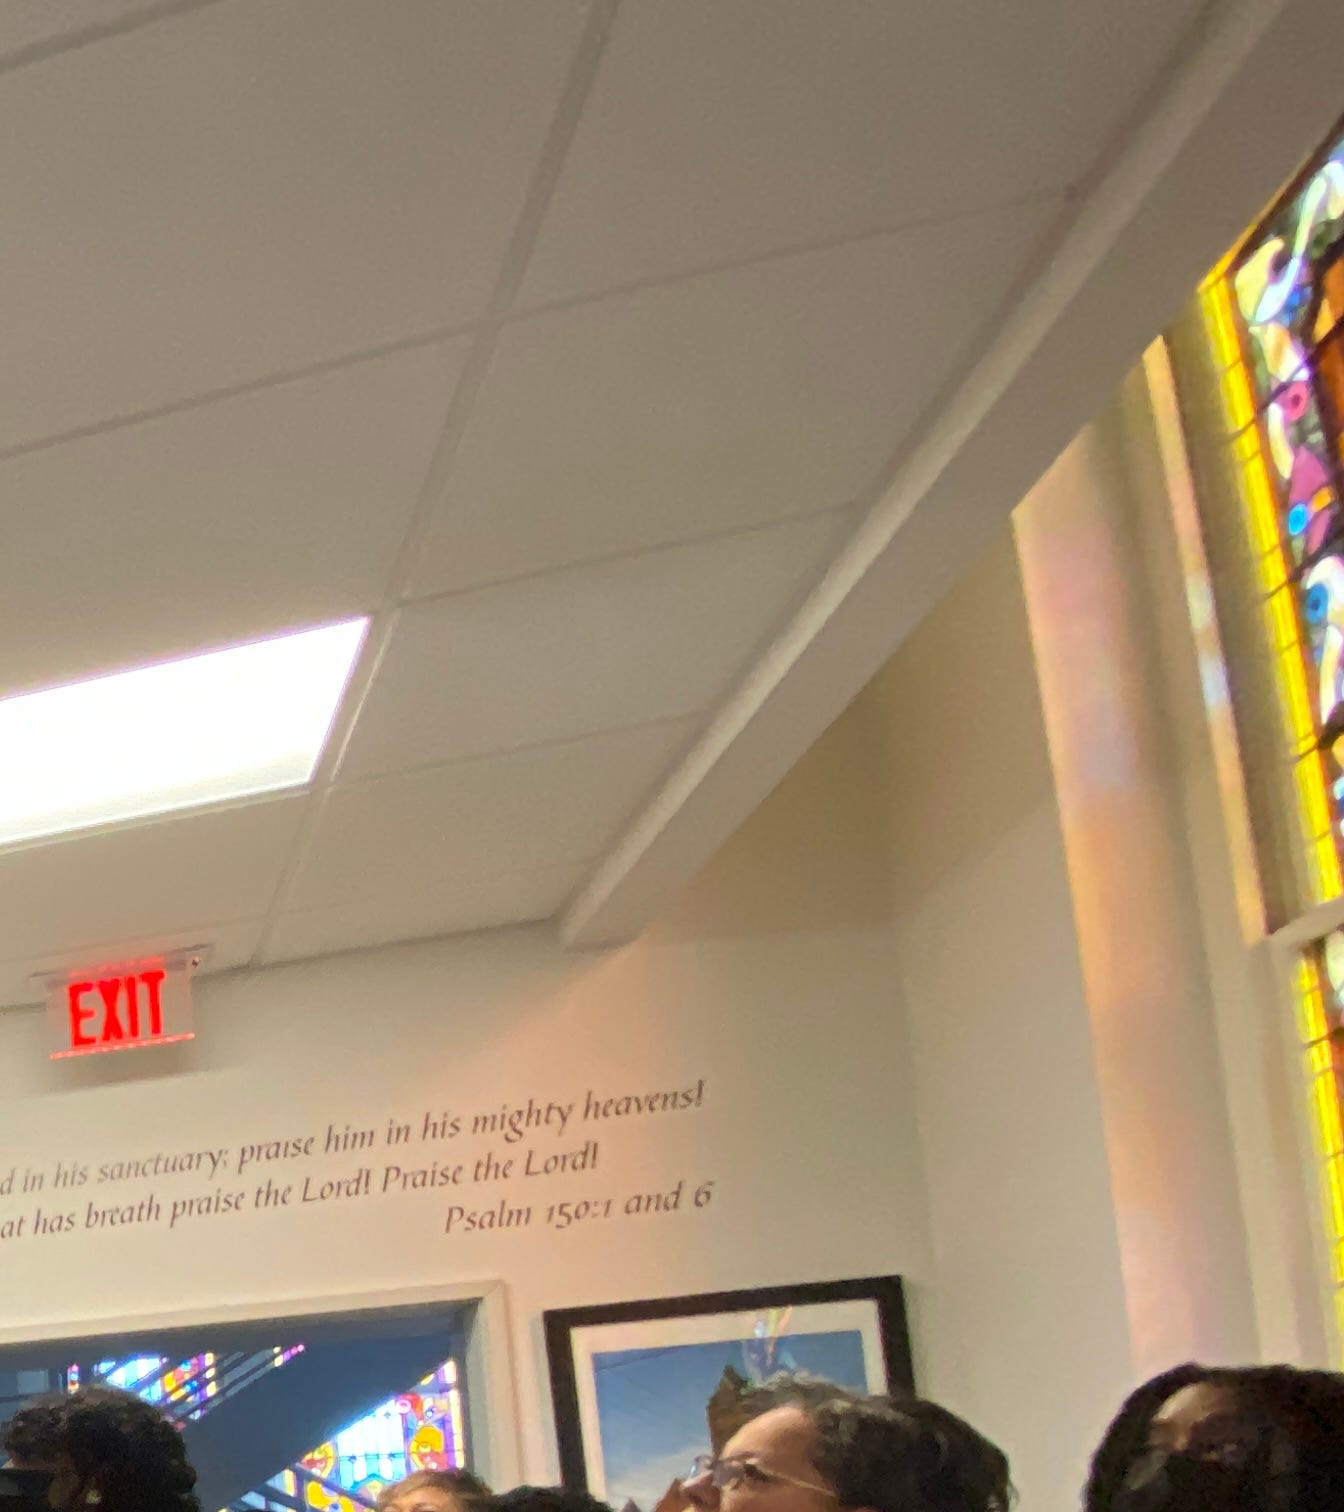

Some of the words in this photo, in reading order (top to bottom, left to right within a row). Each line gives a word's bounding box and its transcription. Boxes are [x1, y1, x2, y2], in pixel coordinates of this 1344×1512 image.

[68, 969, 167, 1048] EXIT
[21, 1167, 45, 1193] in
[52, 1160, 89, 1190] his
[237, 1135, 315, 1175] praise
[323, 1123, 375, 1154] him
[386, 1118, 411, 1146] in
[422, 1111, 462, 1142] his
[471, 1098, 574, 1144] mighty
[582, 1079, 707, 1121] heavens!
[33, 1207, 77, 1236] has
[84, 1194, 161, 1230] breath
[169, 1187, 246, 1229] praise
[254, 1178, 293, 1209] the
[301, 1167, 372, 1203] Lord!
[381, 1160, 464, 1194] Praise
[473, 1151, 514, 1183] the
[524, 1140, 600, 1177] Lord!
[444, 1199, 532, 1234] Psalm
[545, 1198, 615, 1230] 150:1
[623, 1179, 684, 1216] and
[693, 1180, 716, 1209] 6
